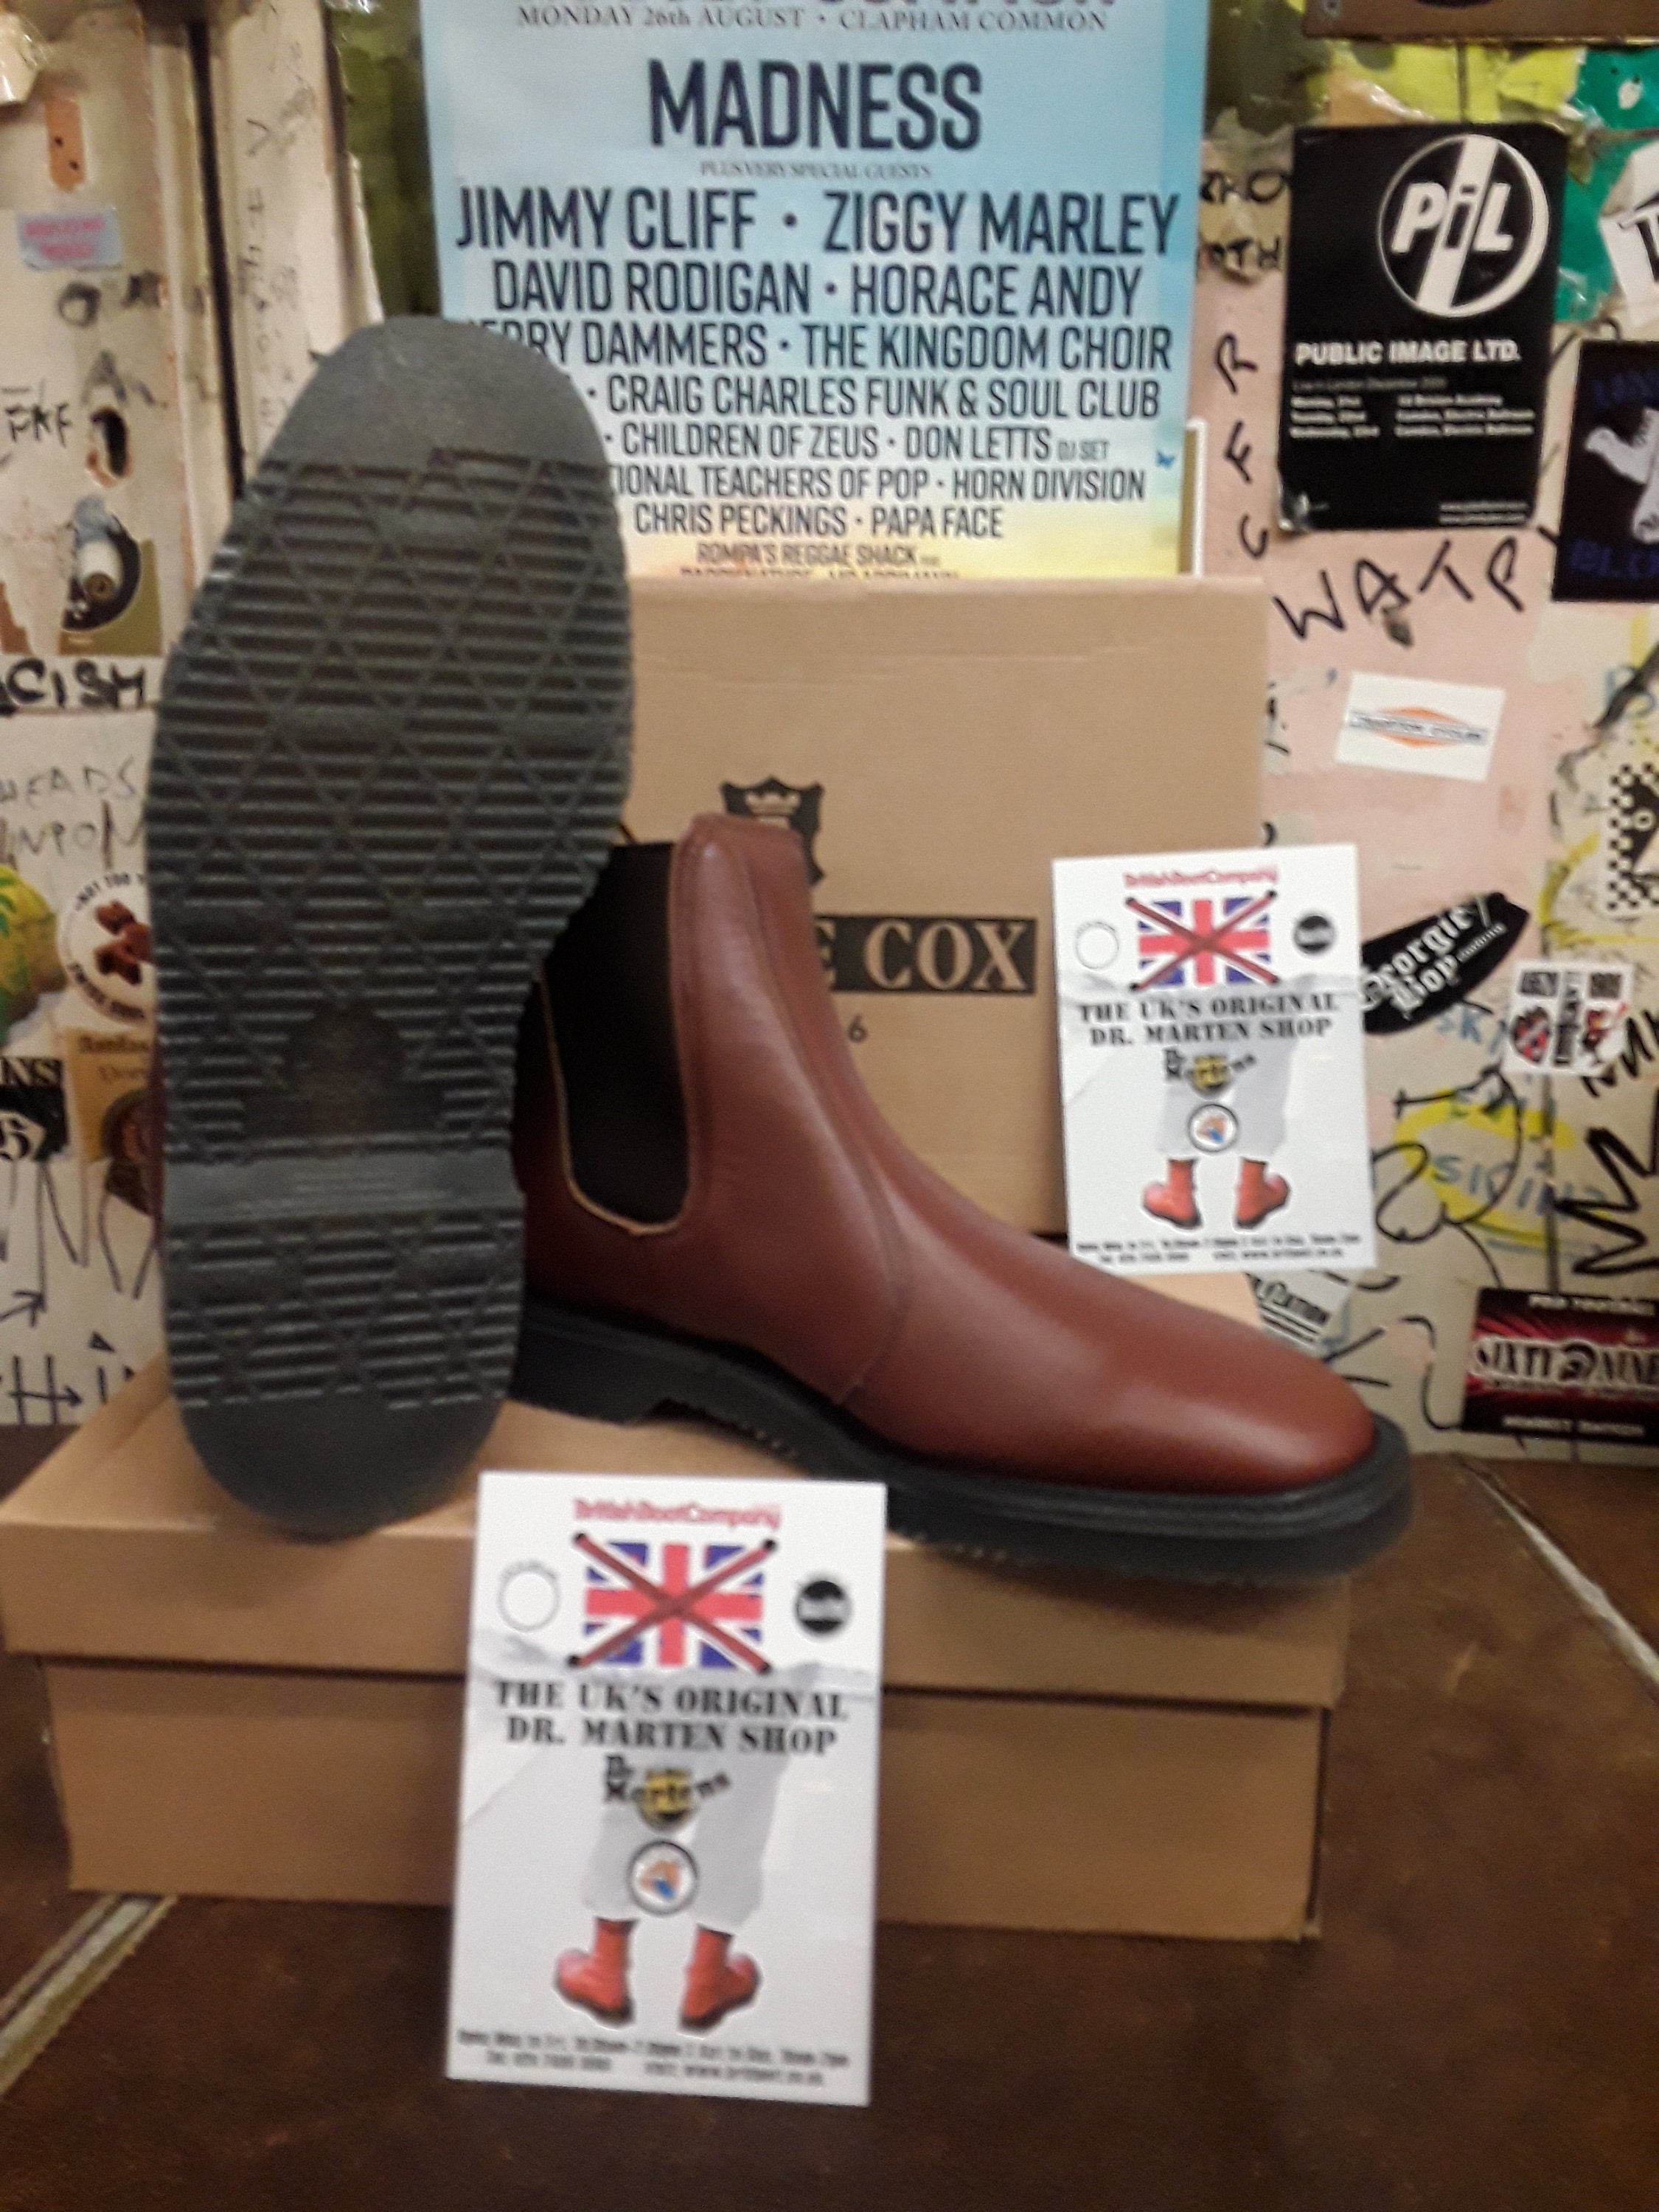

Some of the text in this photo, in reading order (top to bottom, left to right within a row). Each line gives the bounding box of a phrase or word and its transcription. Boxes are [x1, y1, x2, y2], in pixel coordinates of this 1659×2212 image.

[518, 6, 1105, 32] MONDAY 26th AUGUST CLAPHAM COMMON
[650, 58, 982, 151] MADNESS
[864, 161, 932, 179] GUESTS
[456, 185, 613, 250] JIMMY
[627, 186, 757, 251] CLIFF
[823, 191, 967, 254] ZIGGY
[978, 192, 1181, 256] MARLEY
[492, 259, 1143, 318] DAVID RODIGAN HORACE ANDY
[583, 321, 768, 367] DAMMERS
[801, 323, 867, 368] THE
[880, 324, 1048, 369] KINGDOM
[1060, 326, 1174, 371] CHOIR
[1295, 341, 1384, 366] PUBLIC
[1389, 339, 1467, 363] IMAGE
[608, 375, 1161, 419] CRAIG CHARLES FUNK & SOUL CLUB
[622, 422, 760, 456] CHILDREN
[769, 425, 803, 457] OF
[810, 425, 880, 459] ZEUS
[905, 425, 962, 459] DON
[971, 426, 1052, 460] LETTS
[700, 465, 832, 498] TEACHERS
[840, 467, 873, 499] OF
[878, 468, 931, 499] POP
[953, 468, 1026, 500] HORN
[1034, 469, 1146, 501] DIVISION
[634, 502, 1004, 539] CHRIS PECKINGS PAPA FACE
[781, 543, 849, 565] REGGAE
[856, 544, 917, 566] SHACK
[862, 919, 1028, 992] COX
[1079, 992, 1340, 1022] THE UK'S ORIGINAL
[1145, 1021, 1251, 1044] MARTEN
[1259, 1018, 1332, 1040] SHOP
[495, 1680, 849, 1722] THE UK'S ORIGINAL
[507, 1715, 838, 1756] DR. MARTEN SHOP
